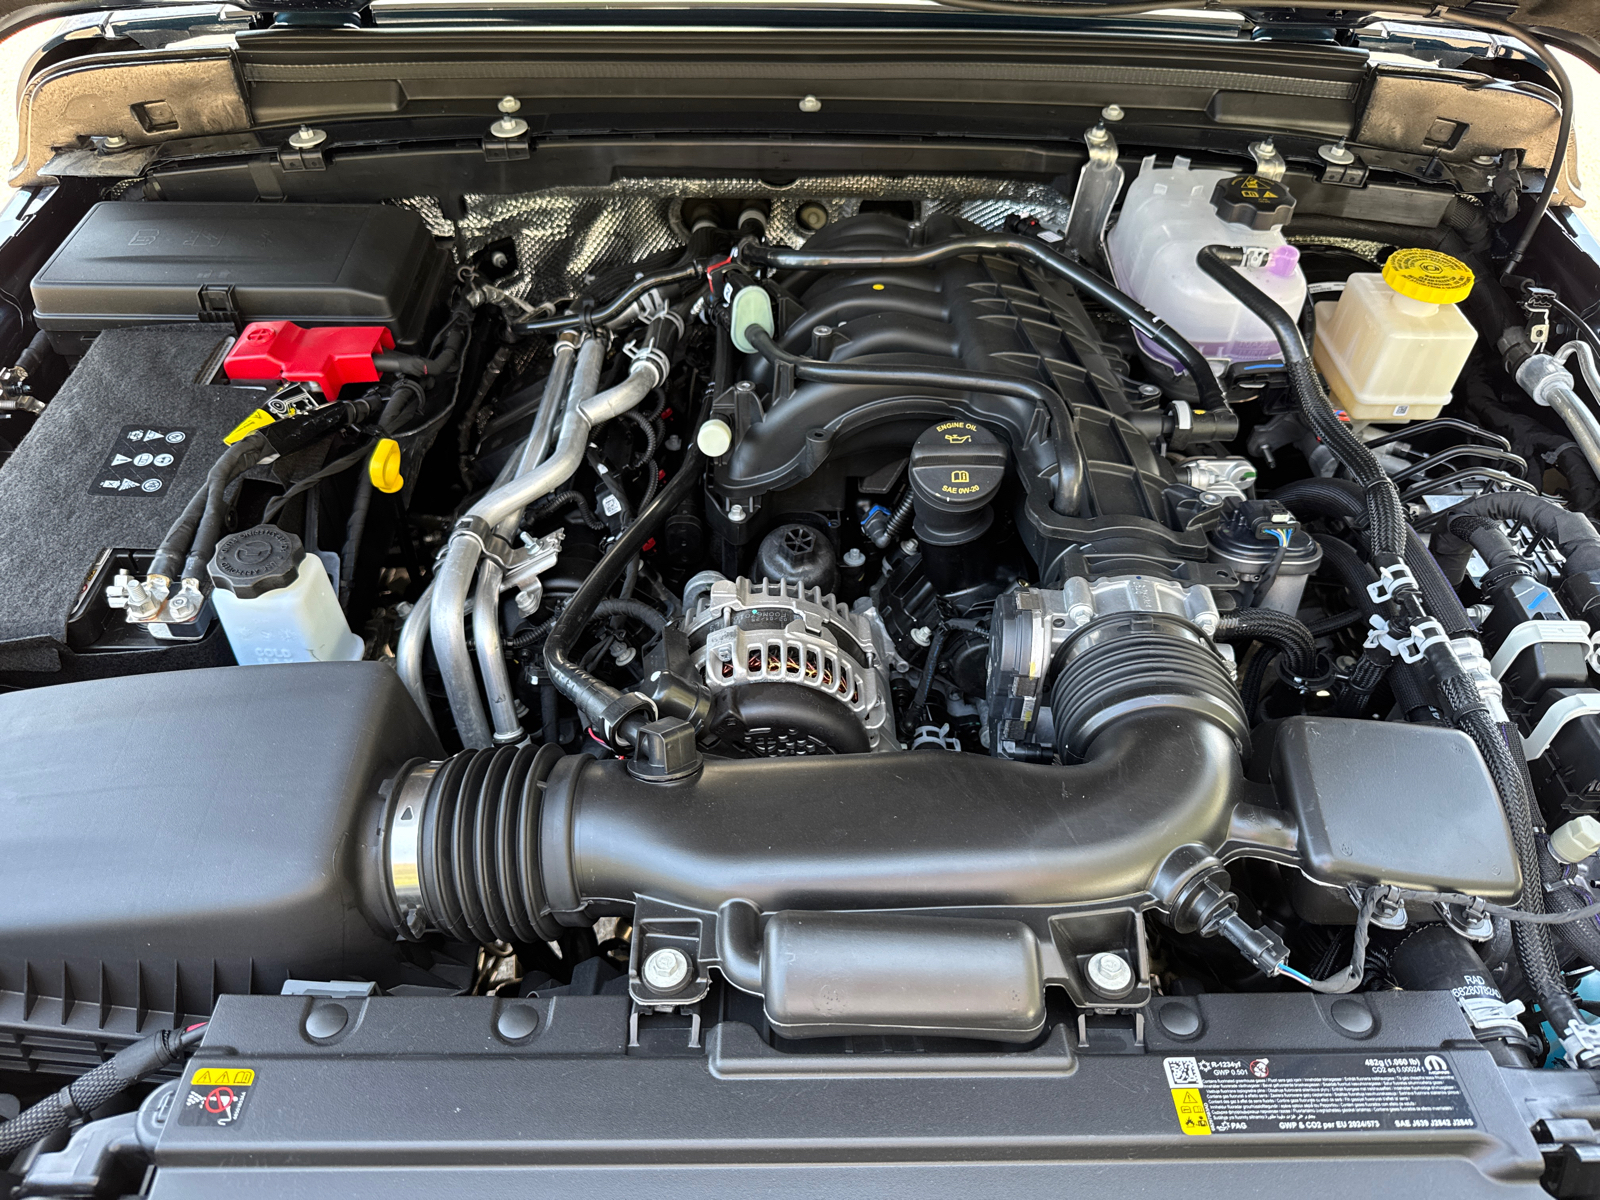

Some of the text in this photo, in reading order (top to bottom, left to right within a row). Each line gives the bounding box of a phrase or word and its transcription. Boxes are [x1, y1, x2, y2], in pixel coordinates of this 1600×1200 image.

[936, 422, 977, 432] ENGINE OIL
[941, 484, 980, 494] SAE 0W-20
[255, 647, 292, 658] COLD
[1463, 975, 1486, 985] RAD
[1210, 1061, 1242, 1069] R-1234yf
[1364, 1058, 1385, 1067] 482g
[1408, 1058, 1421, 1067] lb)
[1371, 1066, 1387, 1074] CO2
[1278, 1121, 1297, 1130] GWP
[1305, 1121, 1322, 1129] CO2
[1322, 1120, 1335, 1130] per
[1335, 1120, 1348, 1128] EU
[1394, 1119, 1411, 1128] SAE
